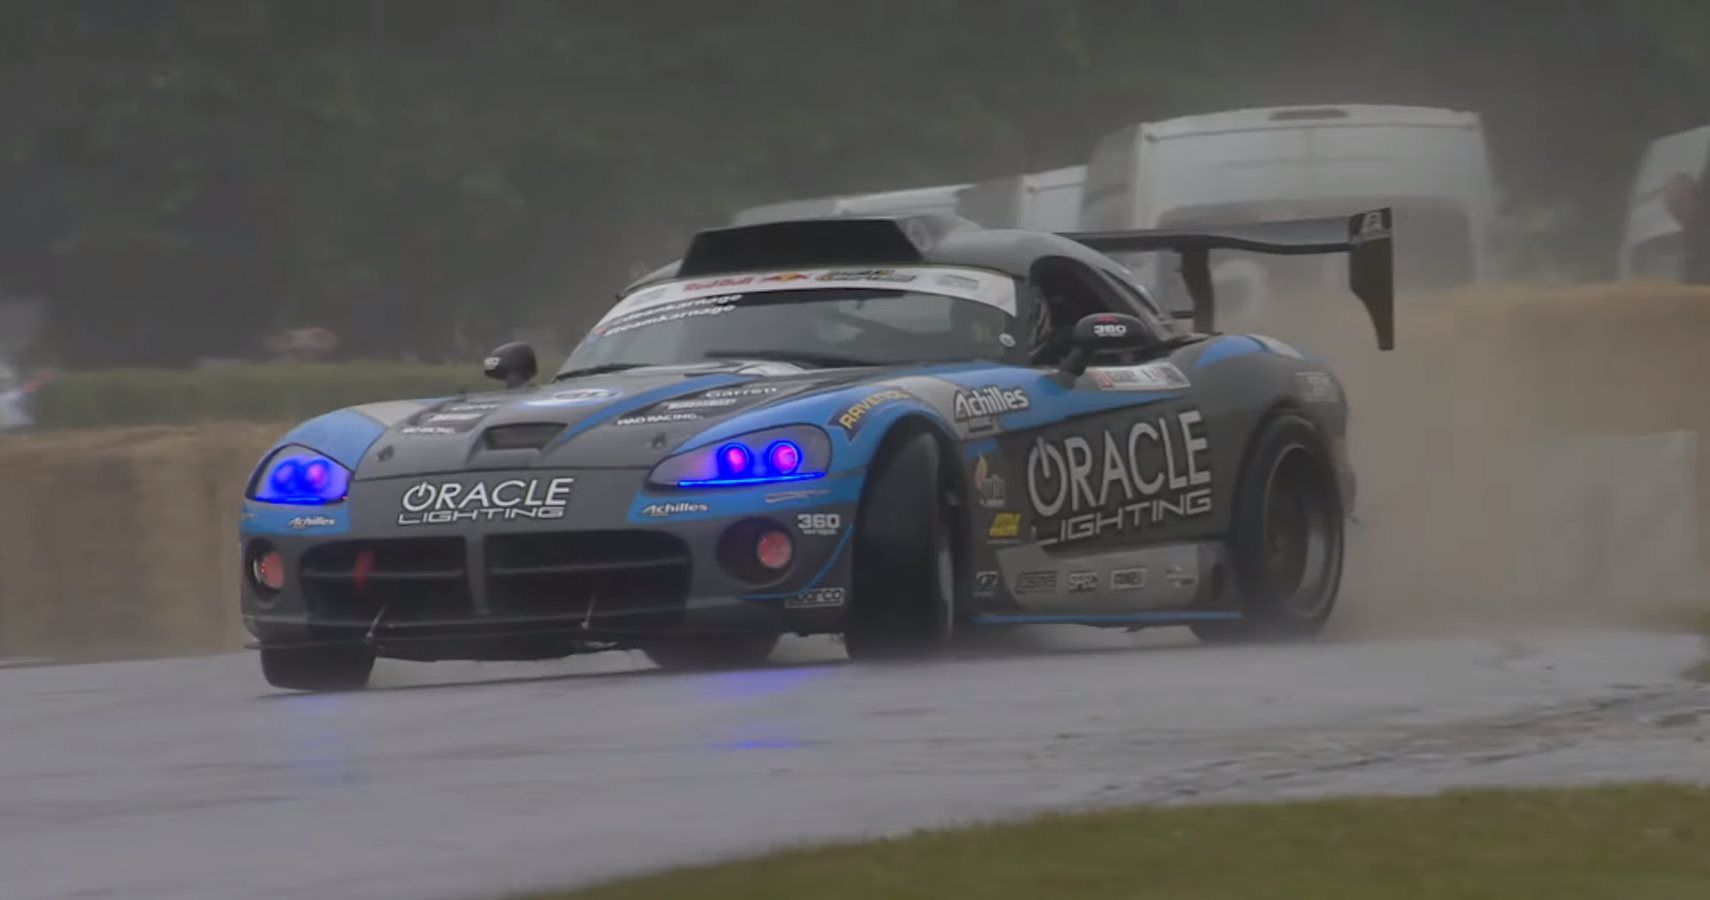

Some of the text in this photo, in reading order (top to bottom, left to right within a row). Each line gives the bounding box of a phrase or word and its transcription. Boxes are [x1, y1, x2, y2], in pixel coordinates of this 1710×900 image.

[1094, 324, 1127, 335] 360
[955, 387, 1030, 419] Achilles
[1028, 410, 1212, 517] ORACLE
[401, 477, 574, 512] ORACLE
[398, 506, 565, 524] LIGHTING
[642, 502, 709, 516] Achilles
[797, 513, 841, 529] 360
[1031, 488, 1213, 546] LIGHTING
